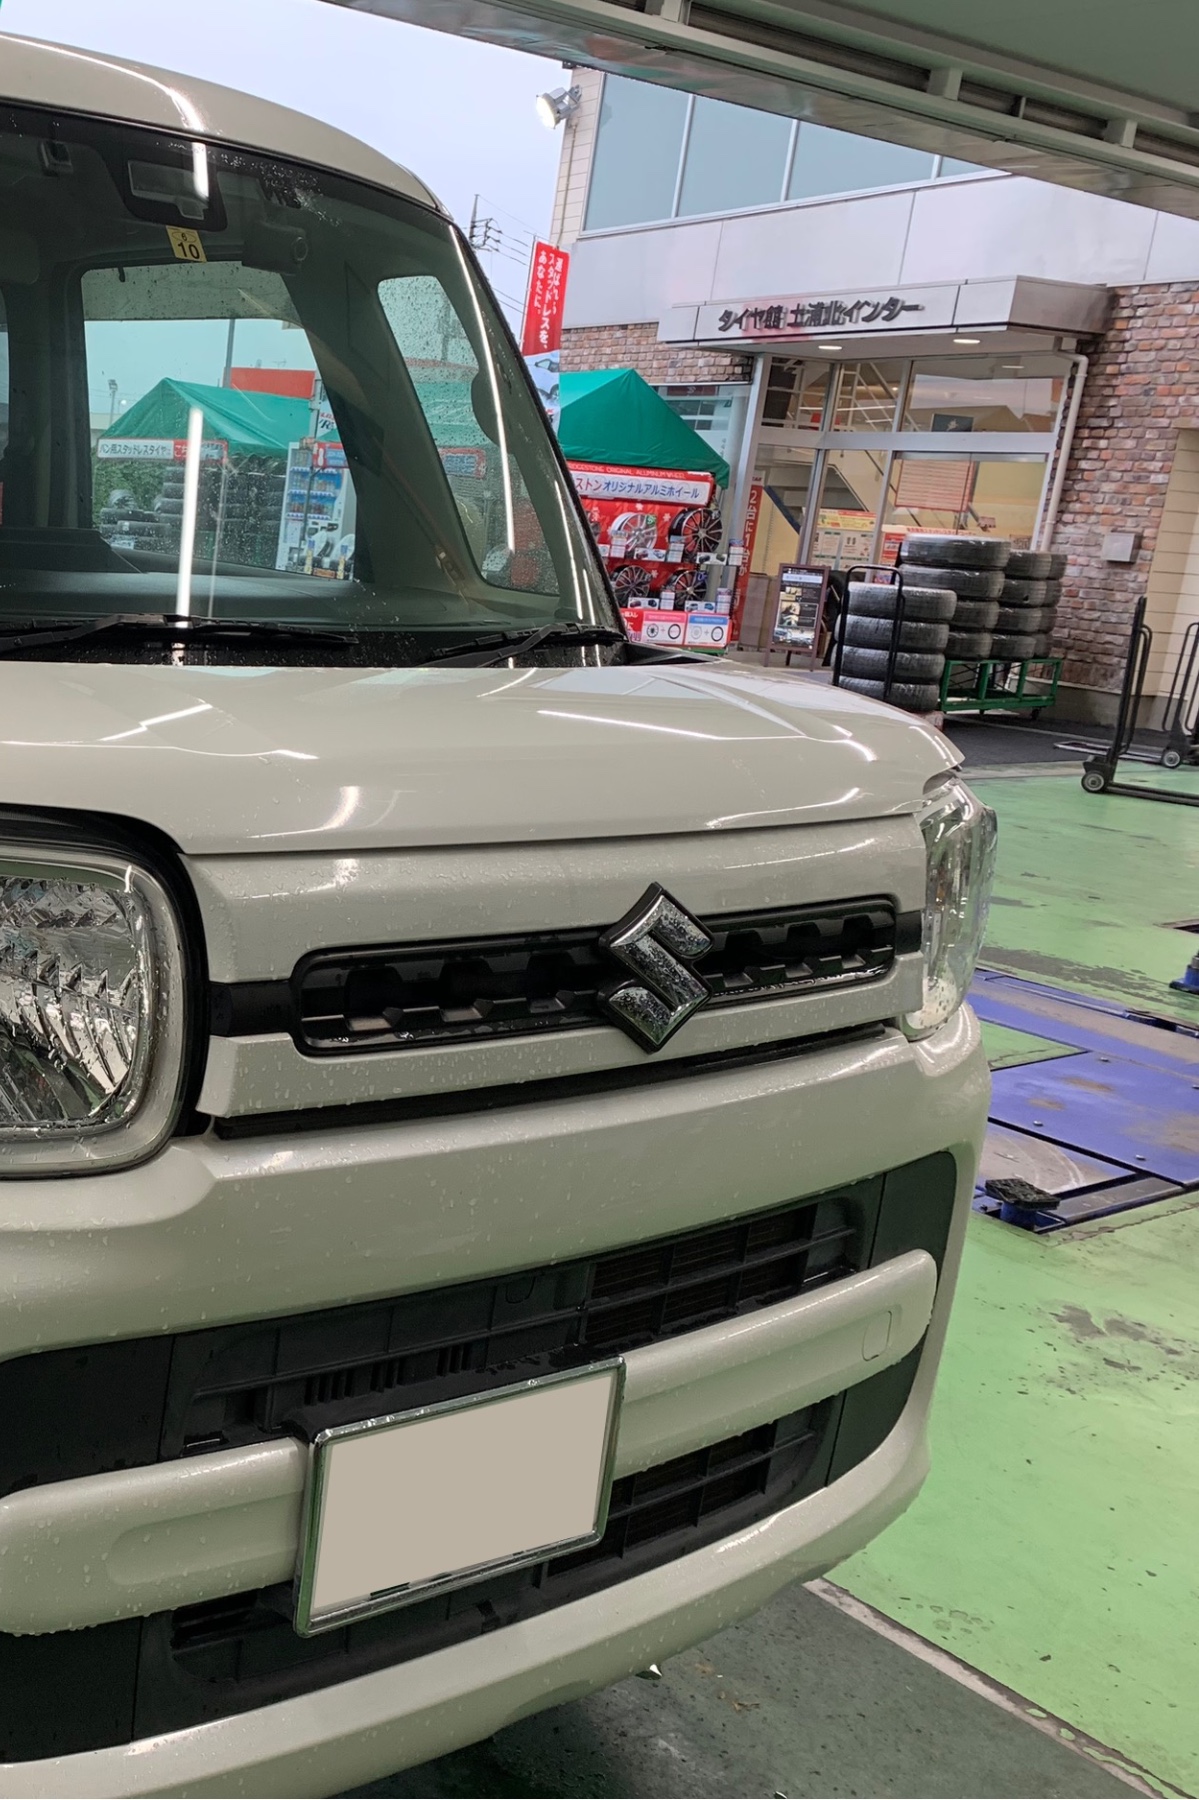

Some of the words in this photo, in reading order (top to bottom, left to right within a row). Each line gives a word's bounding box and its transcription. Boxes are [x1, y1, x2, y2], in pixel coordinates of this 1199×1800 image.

[178, 241, 200, 259] 10
[717, 304, 786, 332] タイヤ館
[787, 296, 925, 328] 土浦北インター
[575, 477, 700, 500] ストンオリジナルアルミホイール
